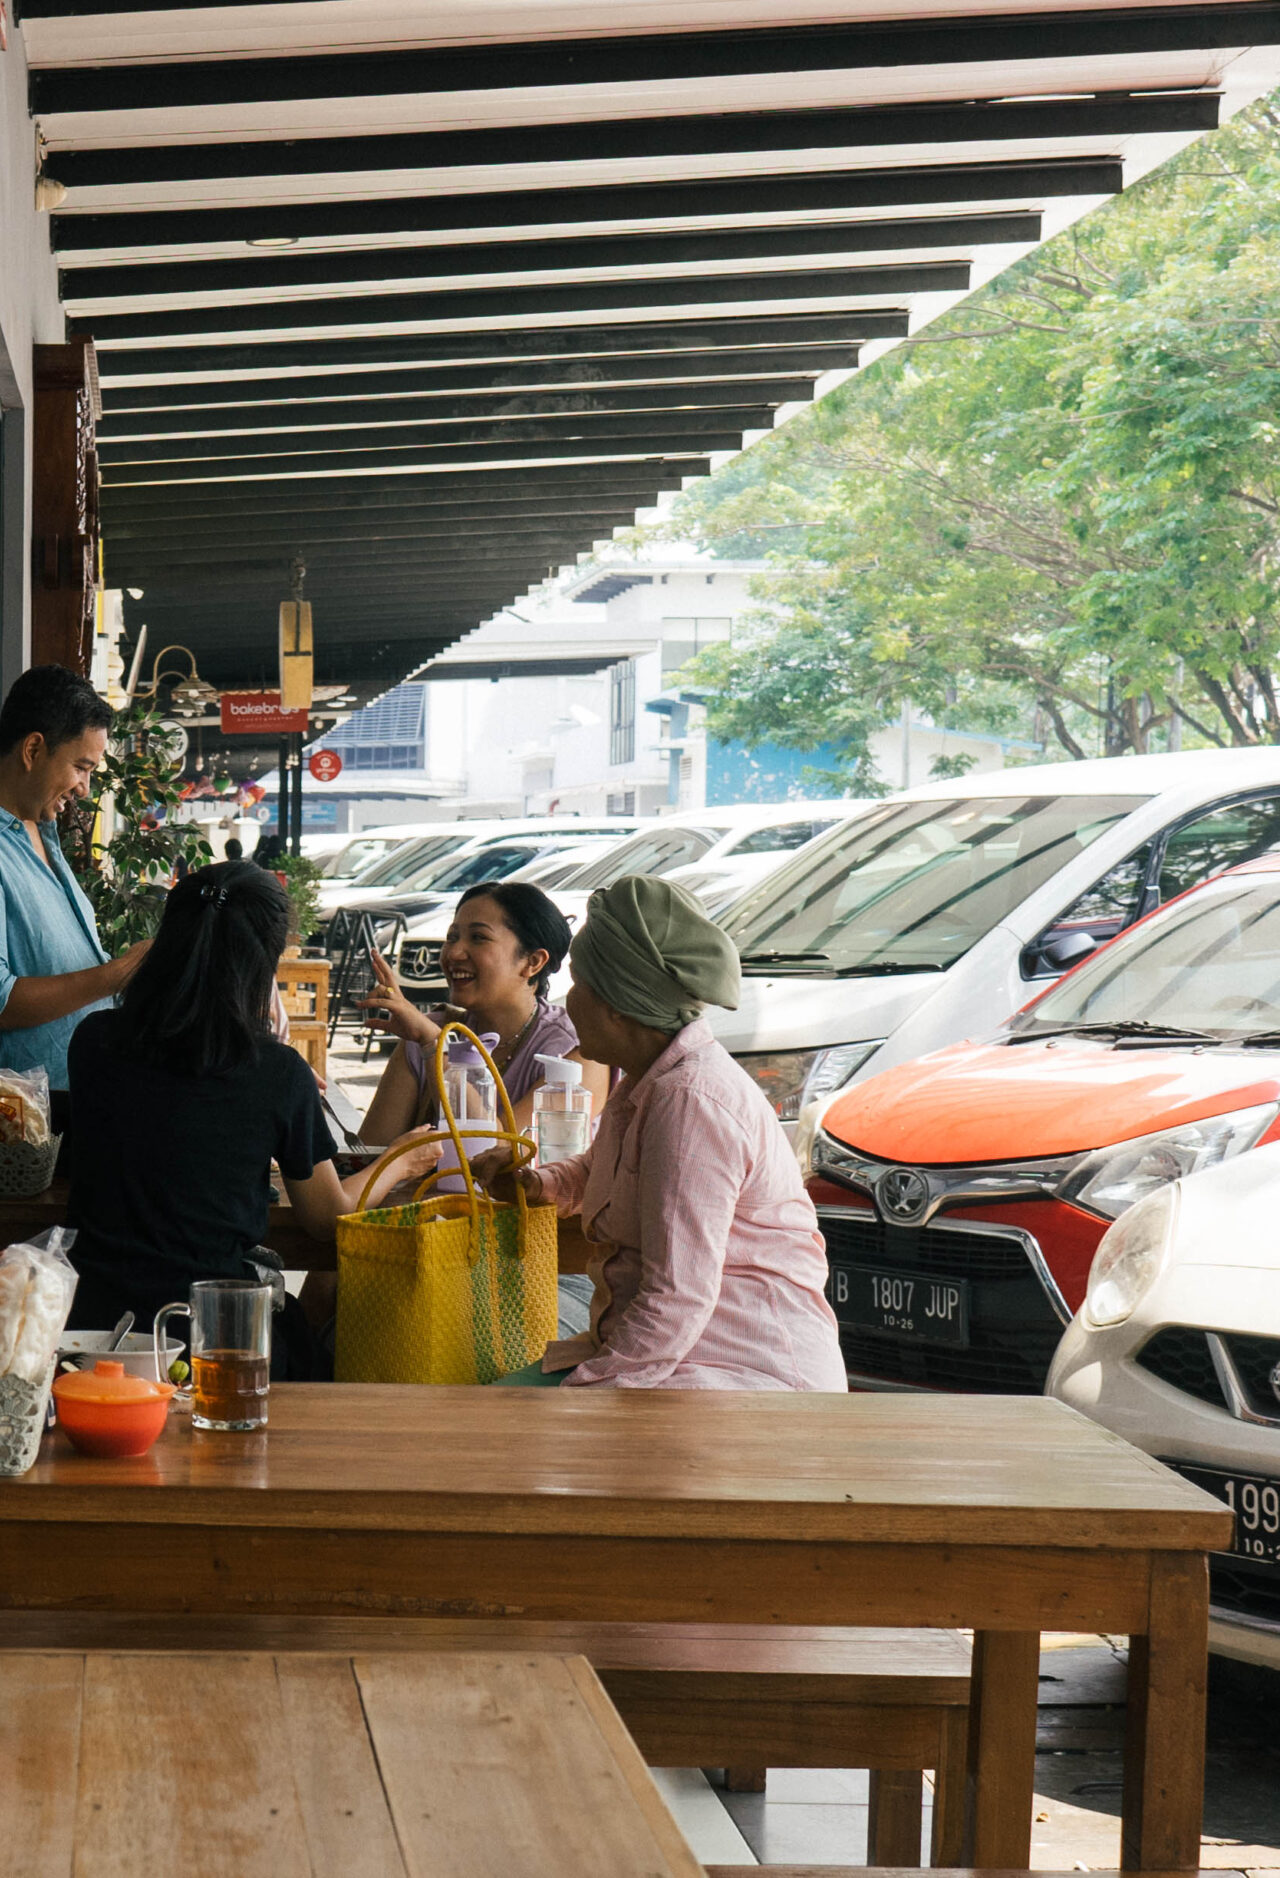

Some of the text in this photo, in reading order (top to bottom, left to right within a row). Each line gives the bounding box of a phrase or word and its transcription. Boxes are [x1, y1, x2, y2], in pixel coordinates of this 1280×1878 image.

[837, 1271, 959, 1320] B 1807 JUP
